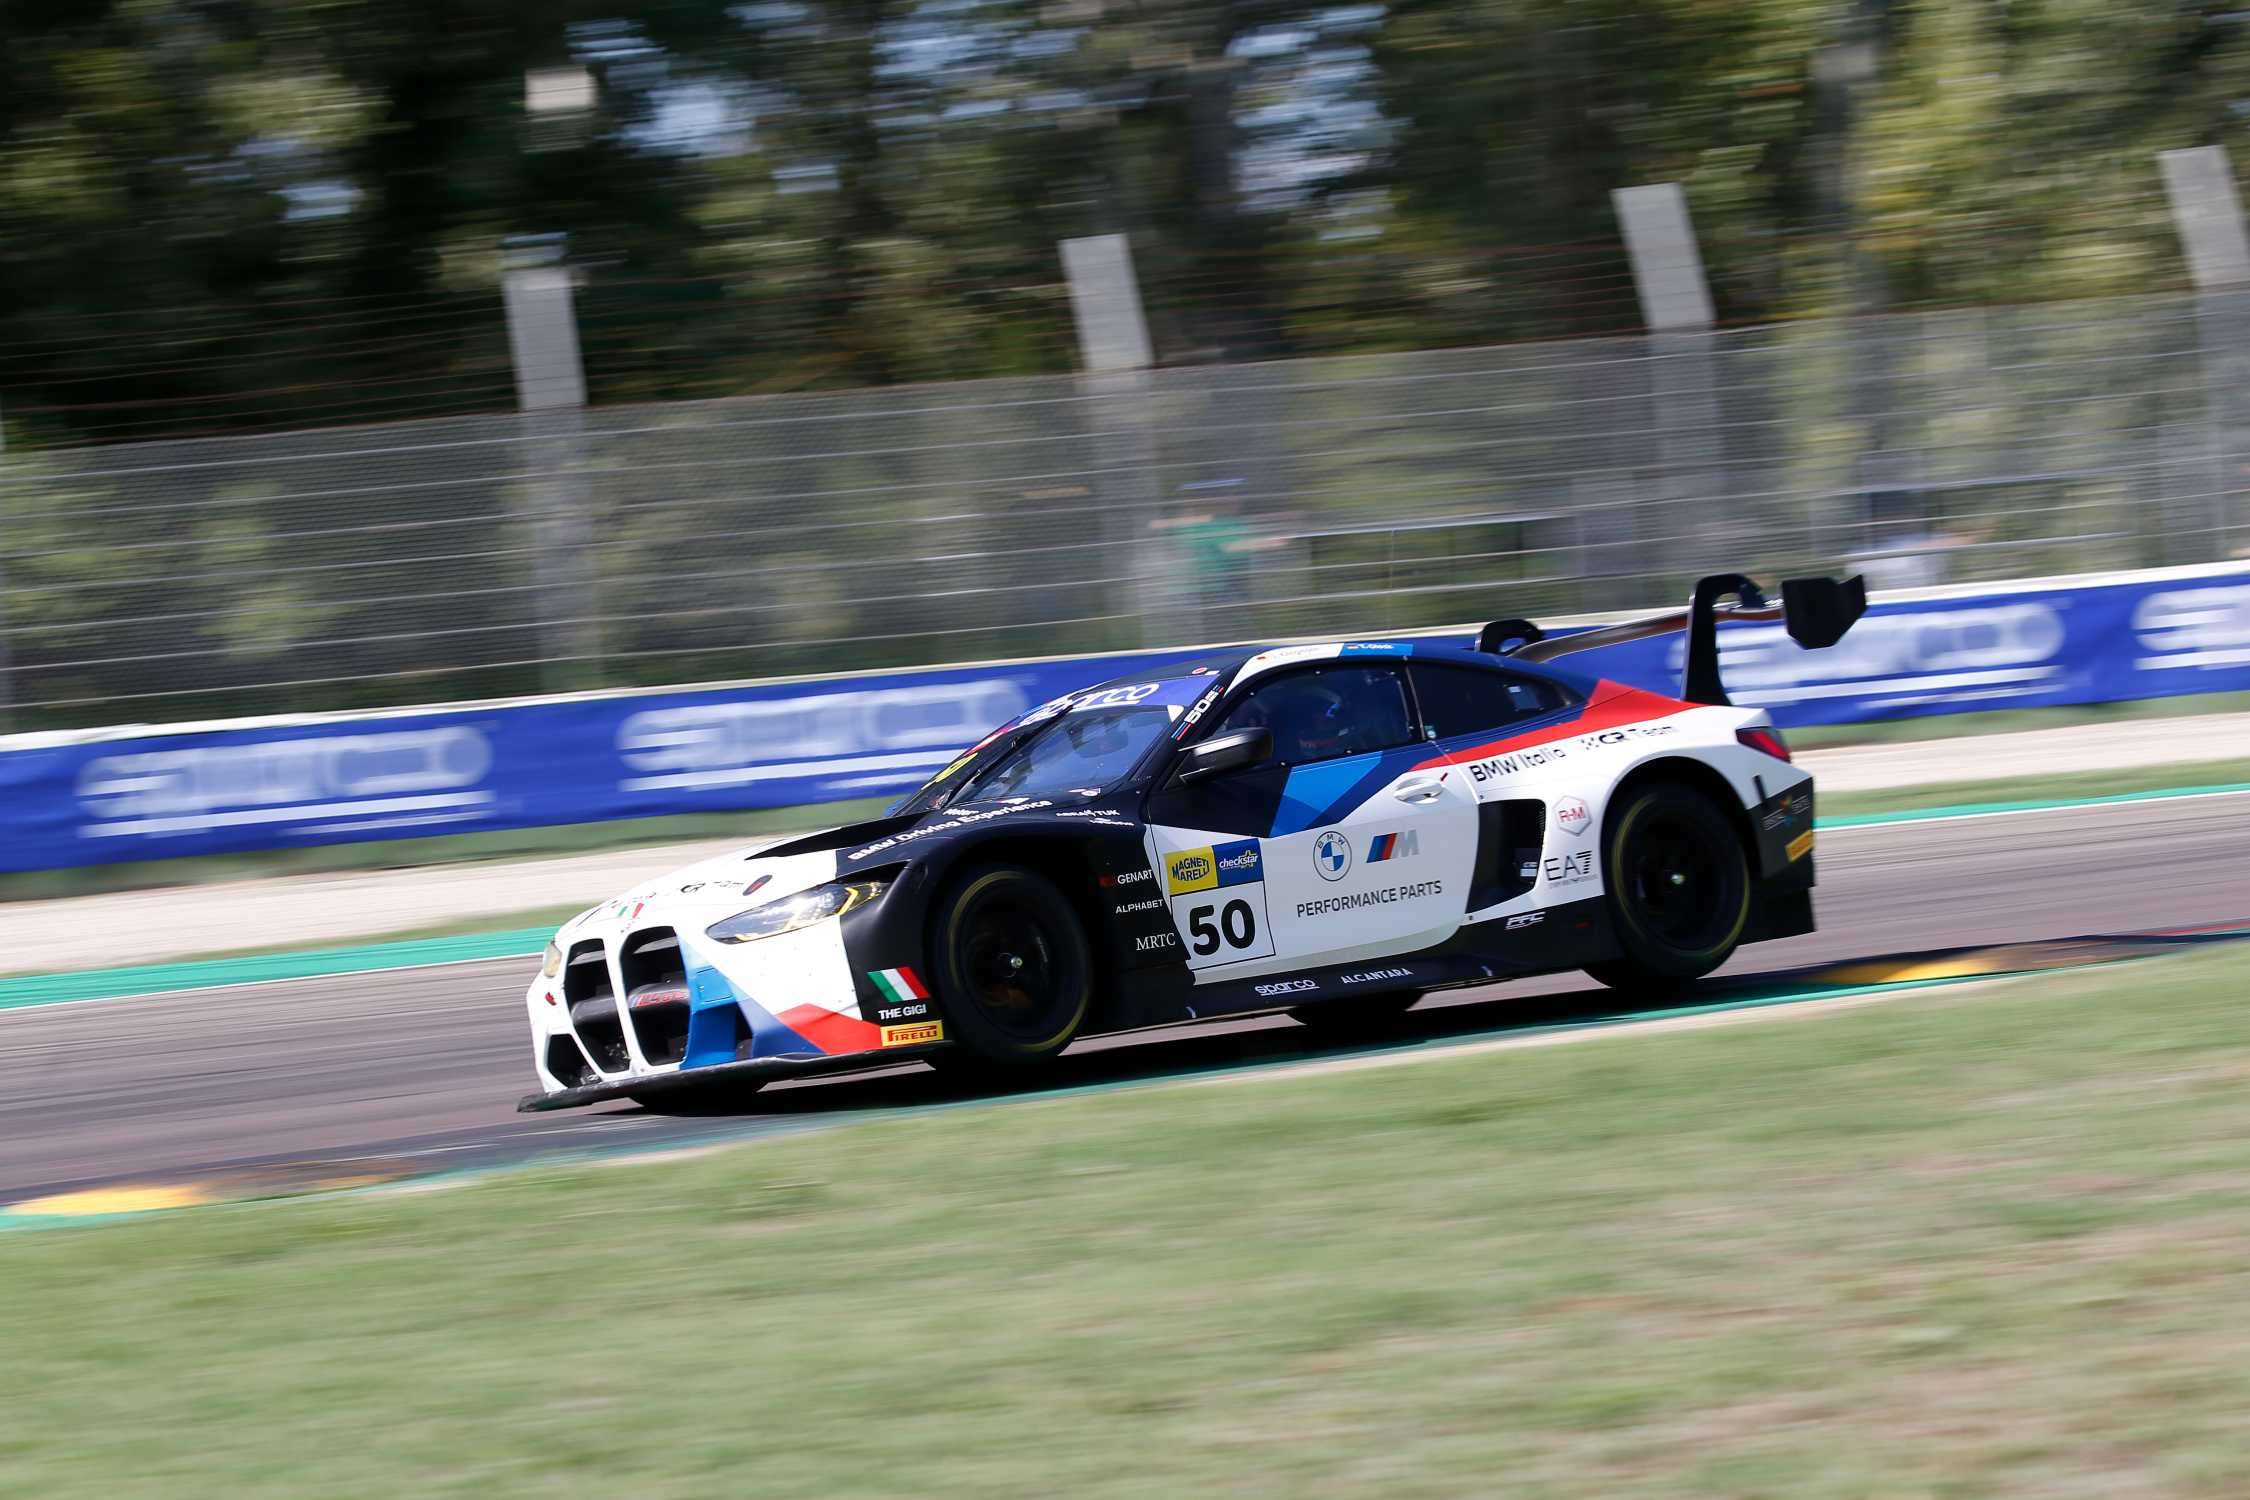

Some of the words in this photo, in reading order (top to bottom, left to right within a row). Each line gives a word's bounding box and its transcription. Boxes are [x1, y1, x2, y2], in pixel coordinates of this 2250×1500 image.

[1469, 756, 1519, 782] BMW
[1517, 747, 1566, 769] Italia
[848, 838, 896, 861] BMW
[896, 819, 961, 842] Driving
[960, 800, 1054, 823] Experience
[1219, 855, 1258, 869] checkstar
[1544, 850, 1592, 881] EA7
[1117, 870, 1153, 885] GENART
[1115, 899, 1164, 914] ALPHABET
[1297, 887, 1398, 918] PERFORMANCE
[1399, 880, 1443, 901] PARTS
[1189, 898, 1256, 956] 50
[1136, 933, 1176, 951] MRTC
[1340, 968, 1415, 984] ALCANTARA
[1254, 979, 1320, 996] sparco
[878, 1008, 902, 1020] THE
[903, 1004, 928, 1016] GIGI
[887, 1024, 938, 1042] PIRELLI
